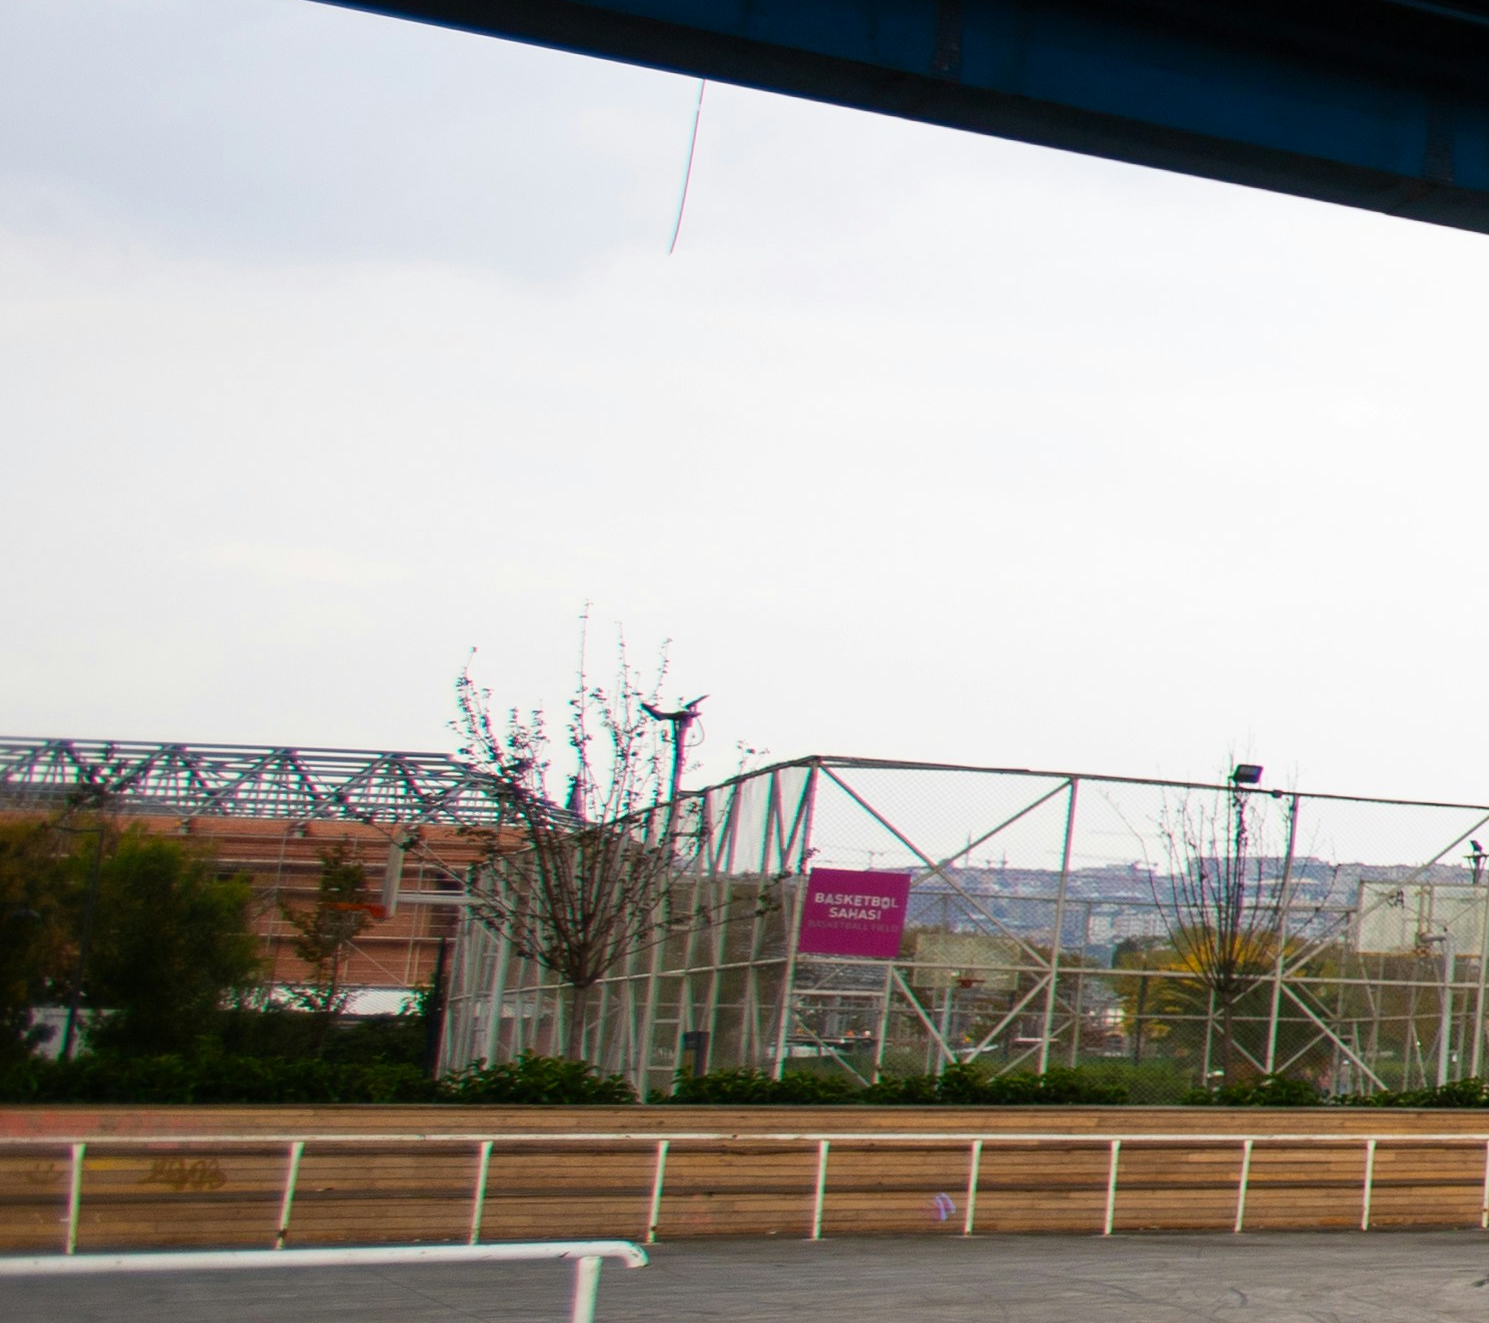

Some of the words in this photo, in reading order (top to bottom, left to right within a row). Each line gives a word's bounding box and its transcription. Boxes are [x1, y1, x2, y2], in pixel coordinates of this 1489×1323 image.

[814, 892, 899, 909] BASKETBOL
[829, 907, 882, 920] SAHASI
[807, 920, 868, 931] BASKETBALL
[871, 924, 899, 933] FIELD
